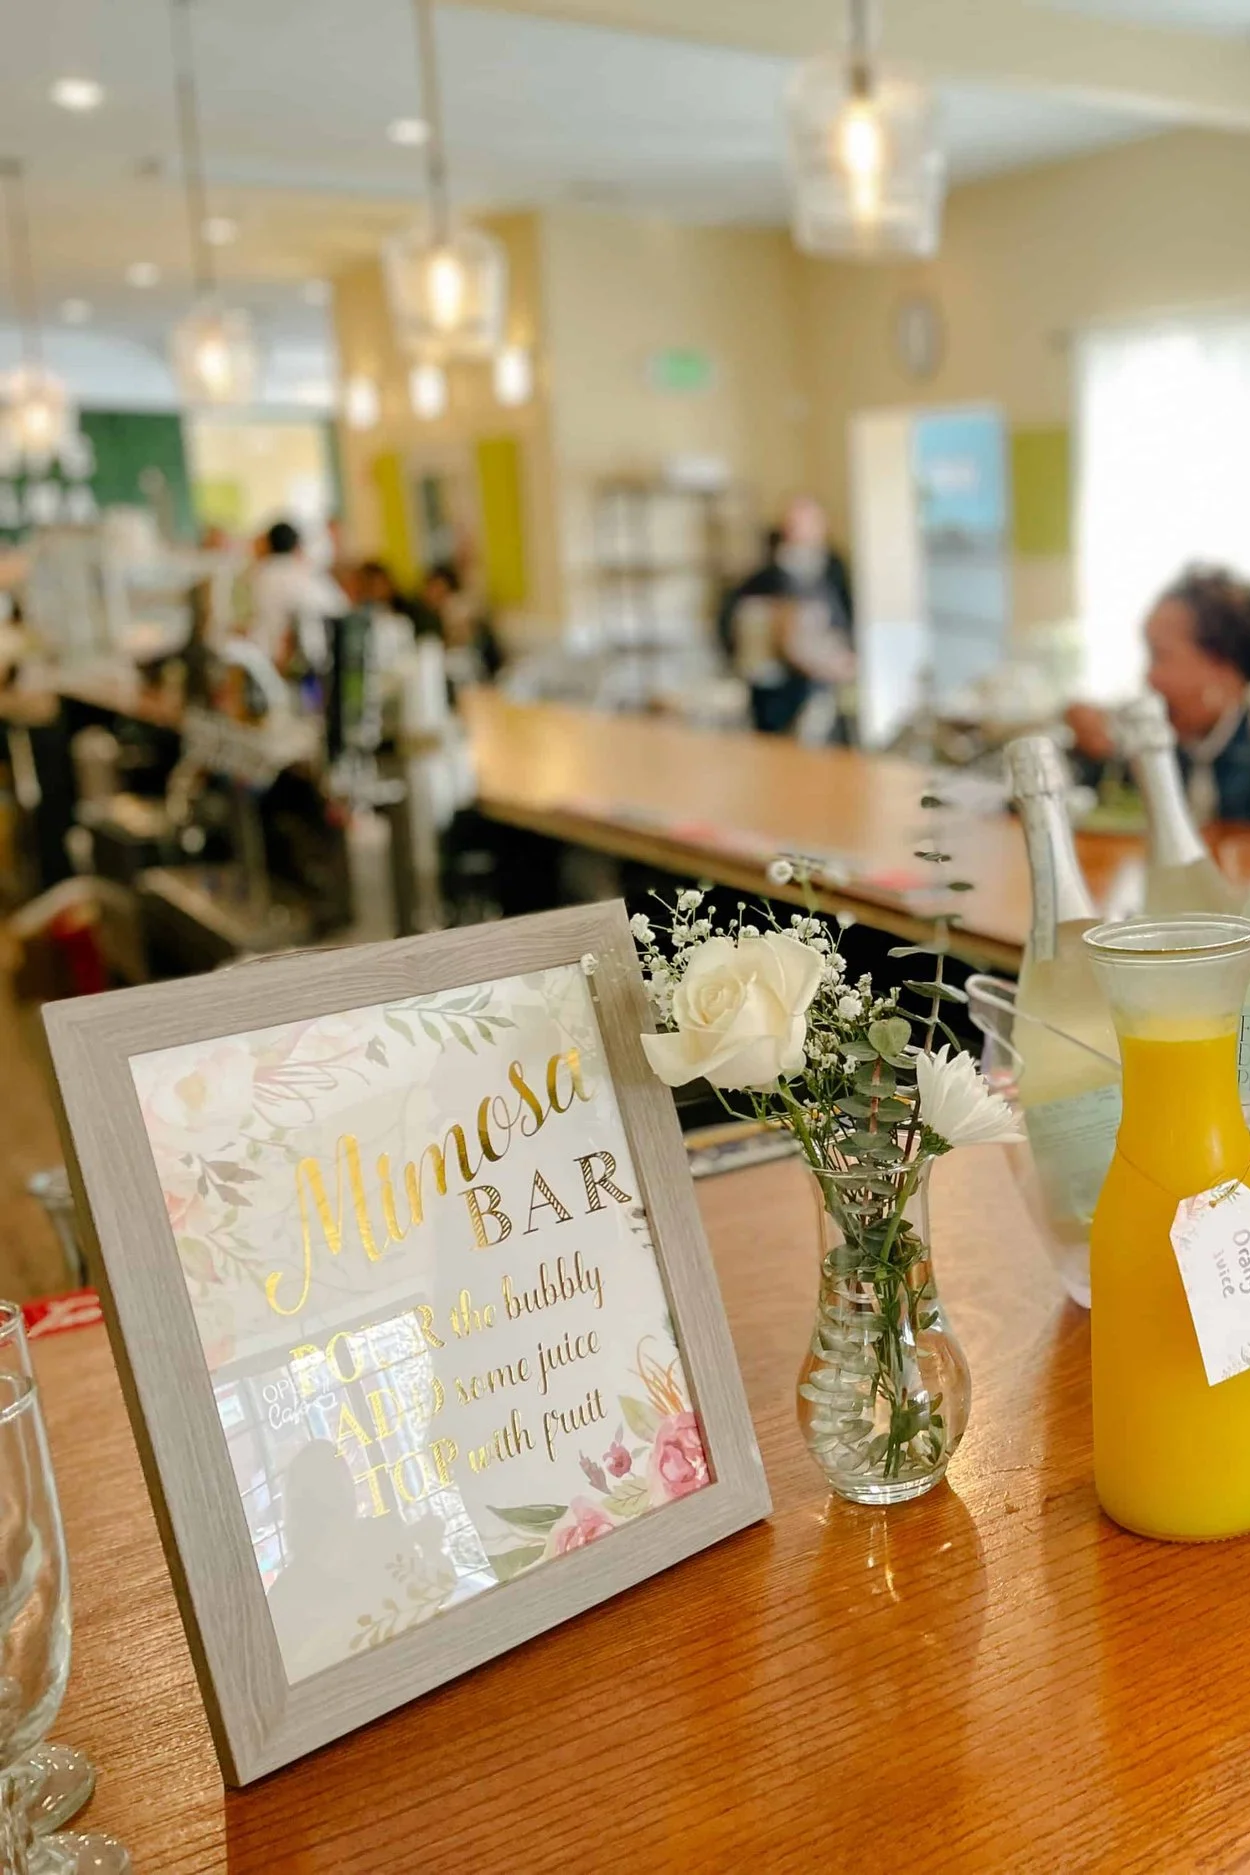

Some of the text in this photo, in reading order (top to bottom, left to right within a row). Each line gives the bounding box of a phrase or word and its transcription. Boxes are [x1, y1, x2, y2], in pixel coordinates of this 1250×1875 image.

[265, 1046, 598, 1315] Mimosa
[457, 1150, 632, 1252] BAR
[448, 1288, 497, 1339] the
[501, 1250, 605, 1320] bubbly
[453, 1357, 533, 1406] some
[537, 1330, 601, 1396] juice
[353, 1388, 608, 1518] TOP with fruit
